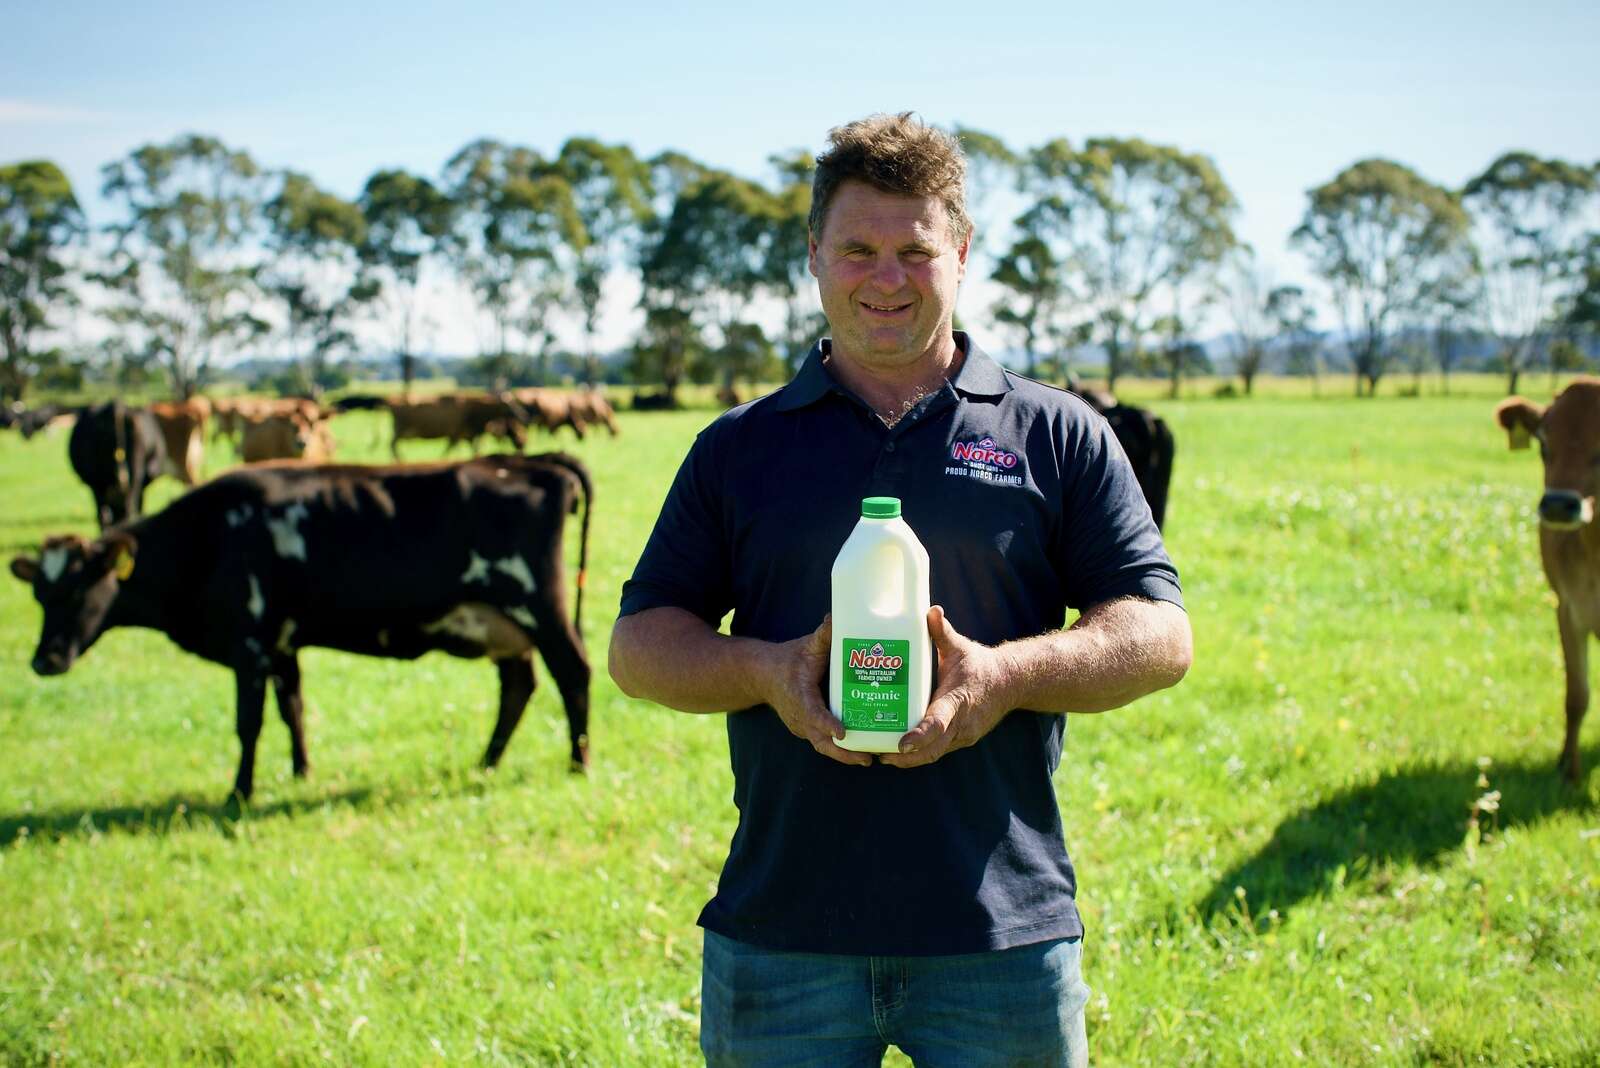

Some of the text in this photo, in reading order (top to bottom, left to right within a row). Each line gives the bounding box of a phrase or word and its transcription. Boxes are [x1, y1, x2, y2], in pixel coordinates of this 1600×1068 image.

[952, 441, 1017, 468] Norco
[945, 467, 968, 476] PROUD
[970, 468, 993, 480] NORCO
[995, 474, 1022, 485] FARMER
[849, 648, 902, 670] Norco
[851, 689, 900, 702] Organic
